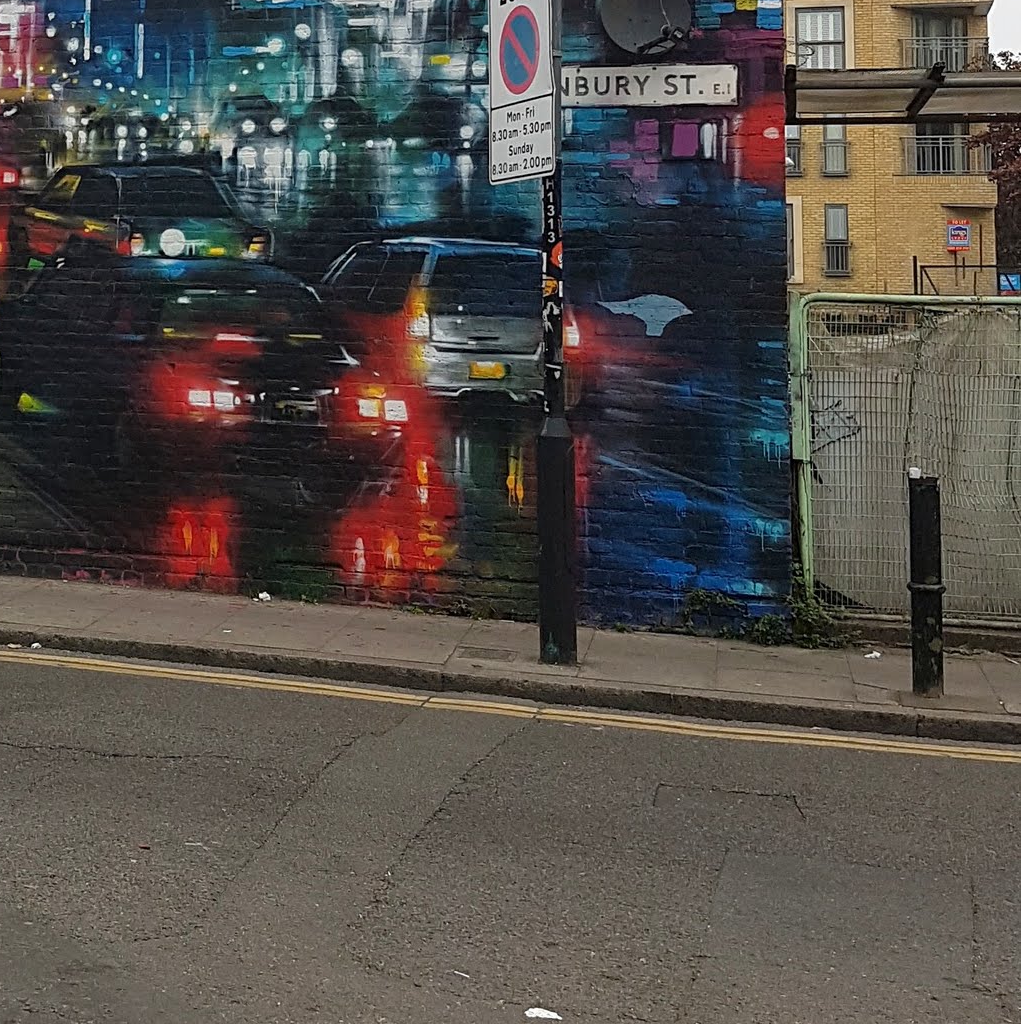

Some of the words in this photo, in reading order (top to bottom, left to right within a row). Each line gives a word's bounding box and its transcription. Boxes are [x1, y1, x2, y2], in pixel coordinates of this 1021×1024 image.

[664, 74, 704, 95] ST.
[492, 129, 508, 142] 8.30
[523, 121, 539, 135] 5.30
[508, 142, 534, 156] Sunday
[492, 162, 508, 175] 8.30
[523, 156, 540, 170] 2.00
